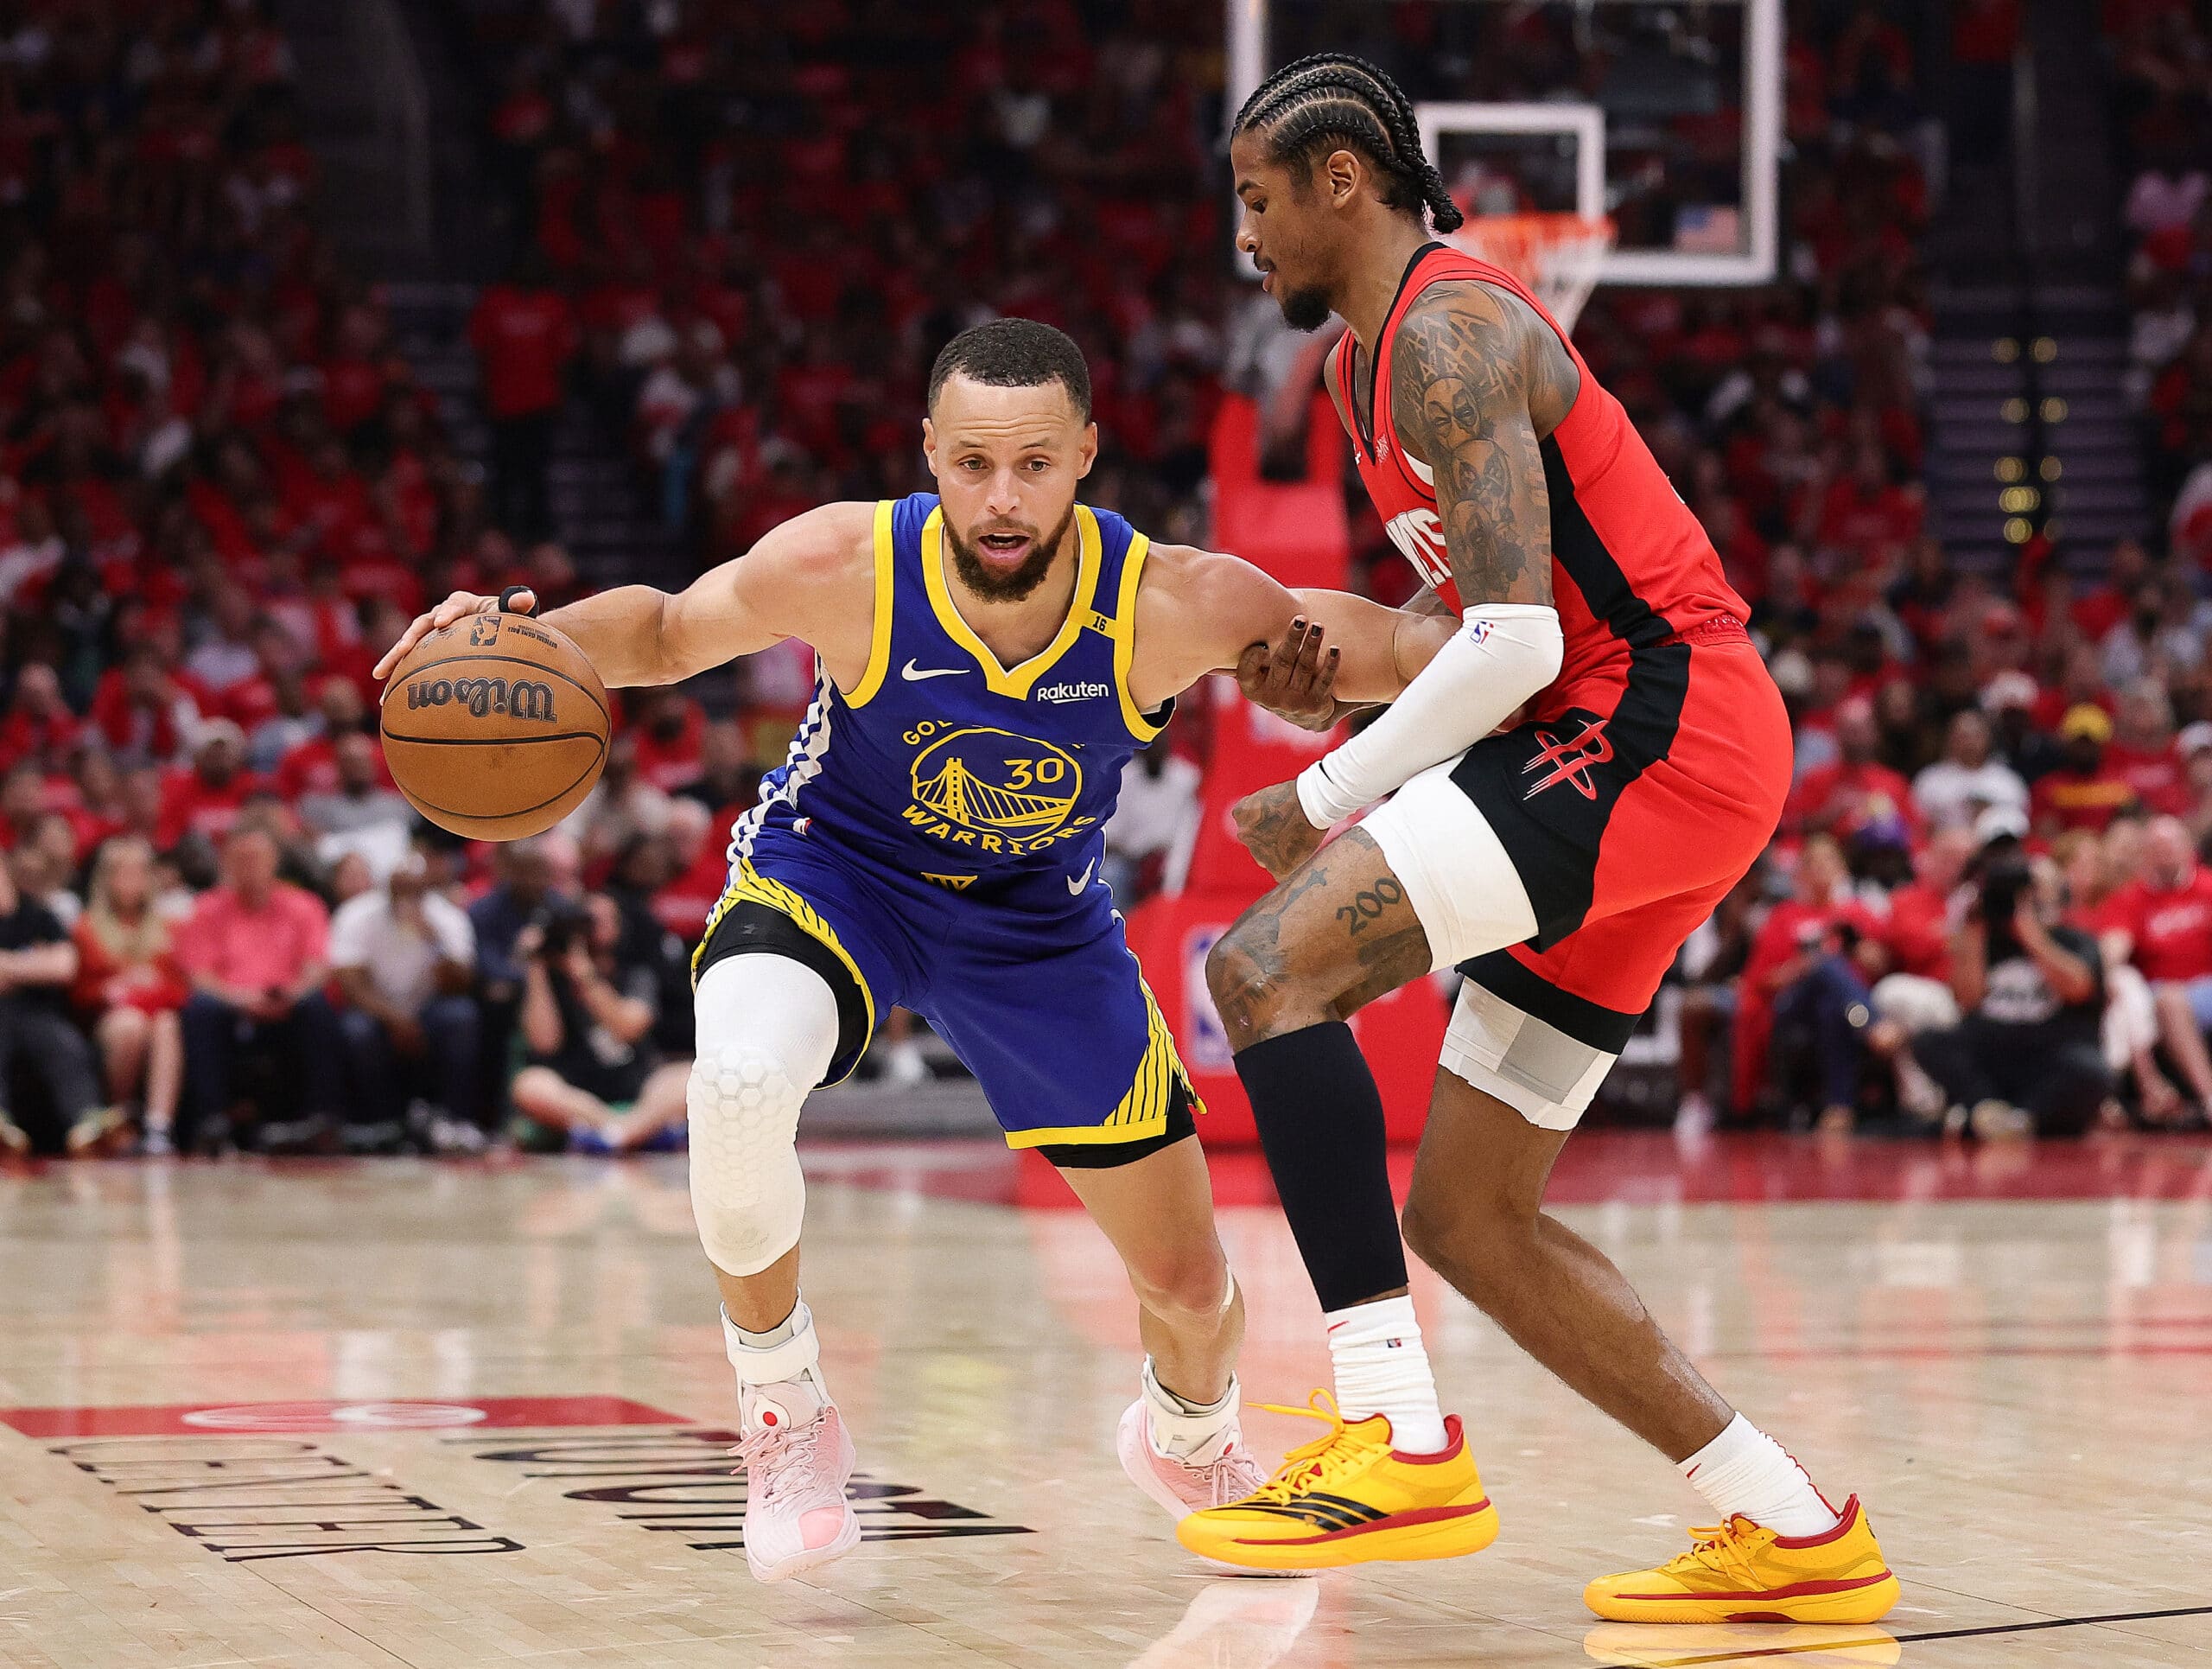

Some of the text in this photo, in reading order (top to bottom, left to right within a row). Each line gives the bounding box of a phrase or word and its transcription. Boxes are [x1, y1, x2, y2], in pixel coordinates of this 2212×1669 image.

[1092, 615, 1107, 632] 16
[407, 677, 557, 724] Wilson
[1037, 681, 1109, 702] Rakuten
[1003, 758, 1065, 791] 30
[901, 805, 1096, 856] WARRIORS
[1336, 877, 1401, 936] 200
[48, 1438, 526, 1563] CENTER
